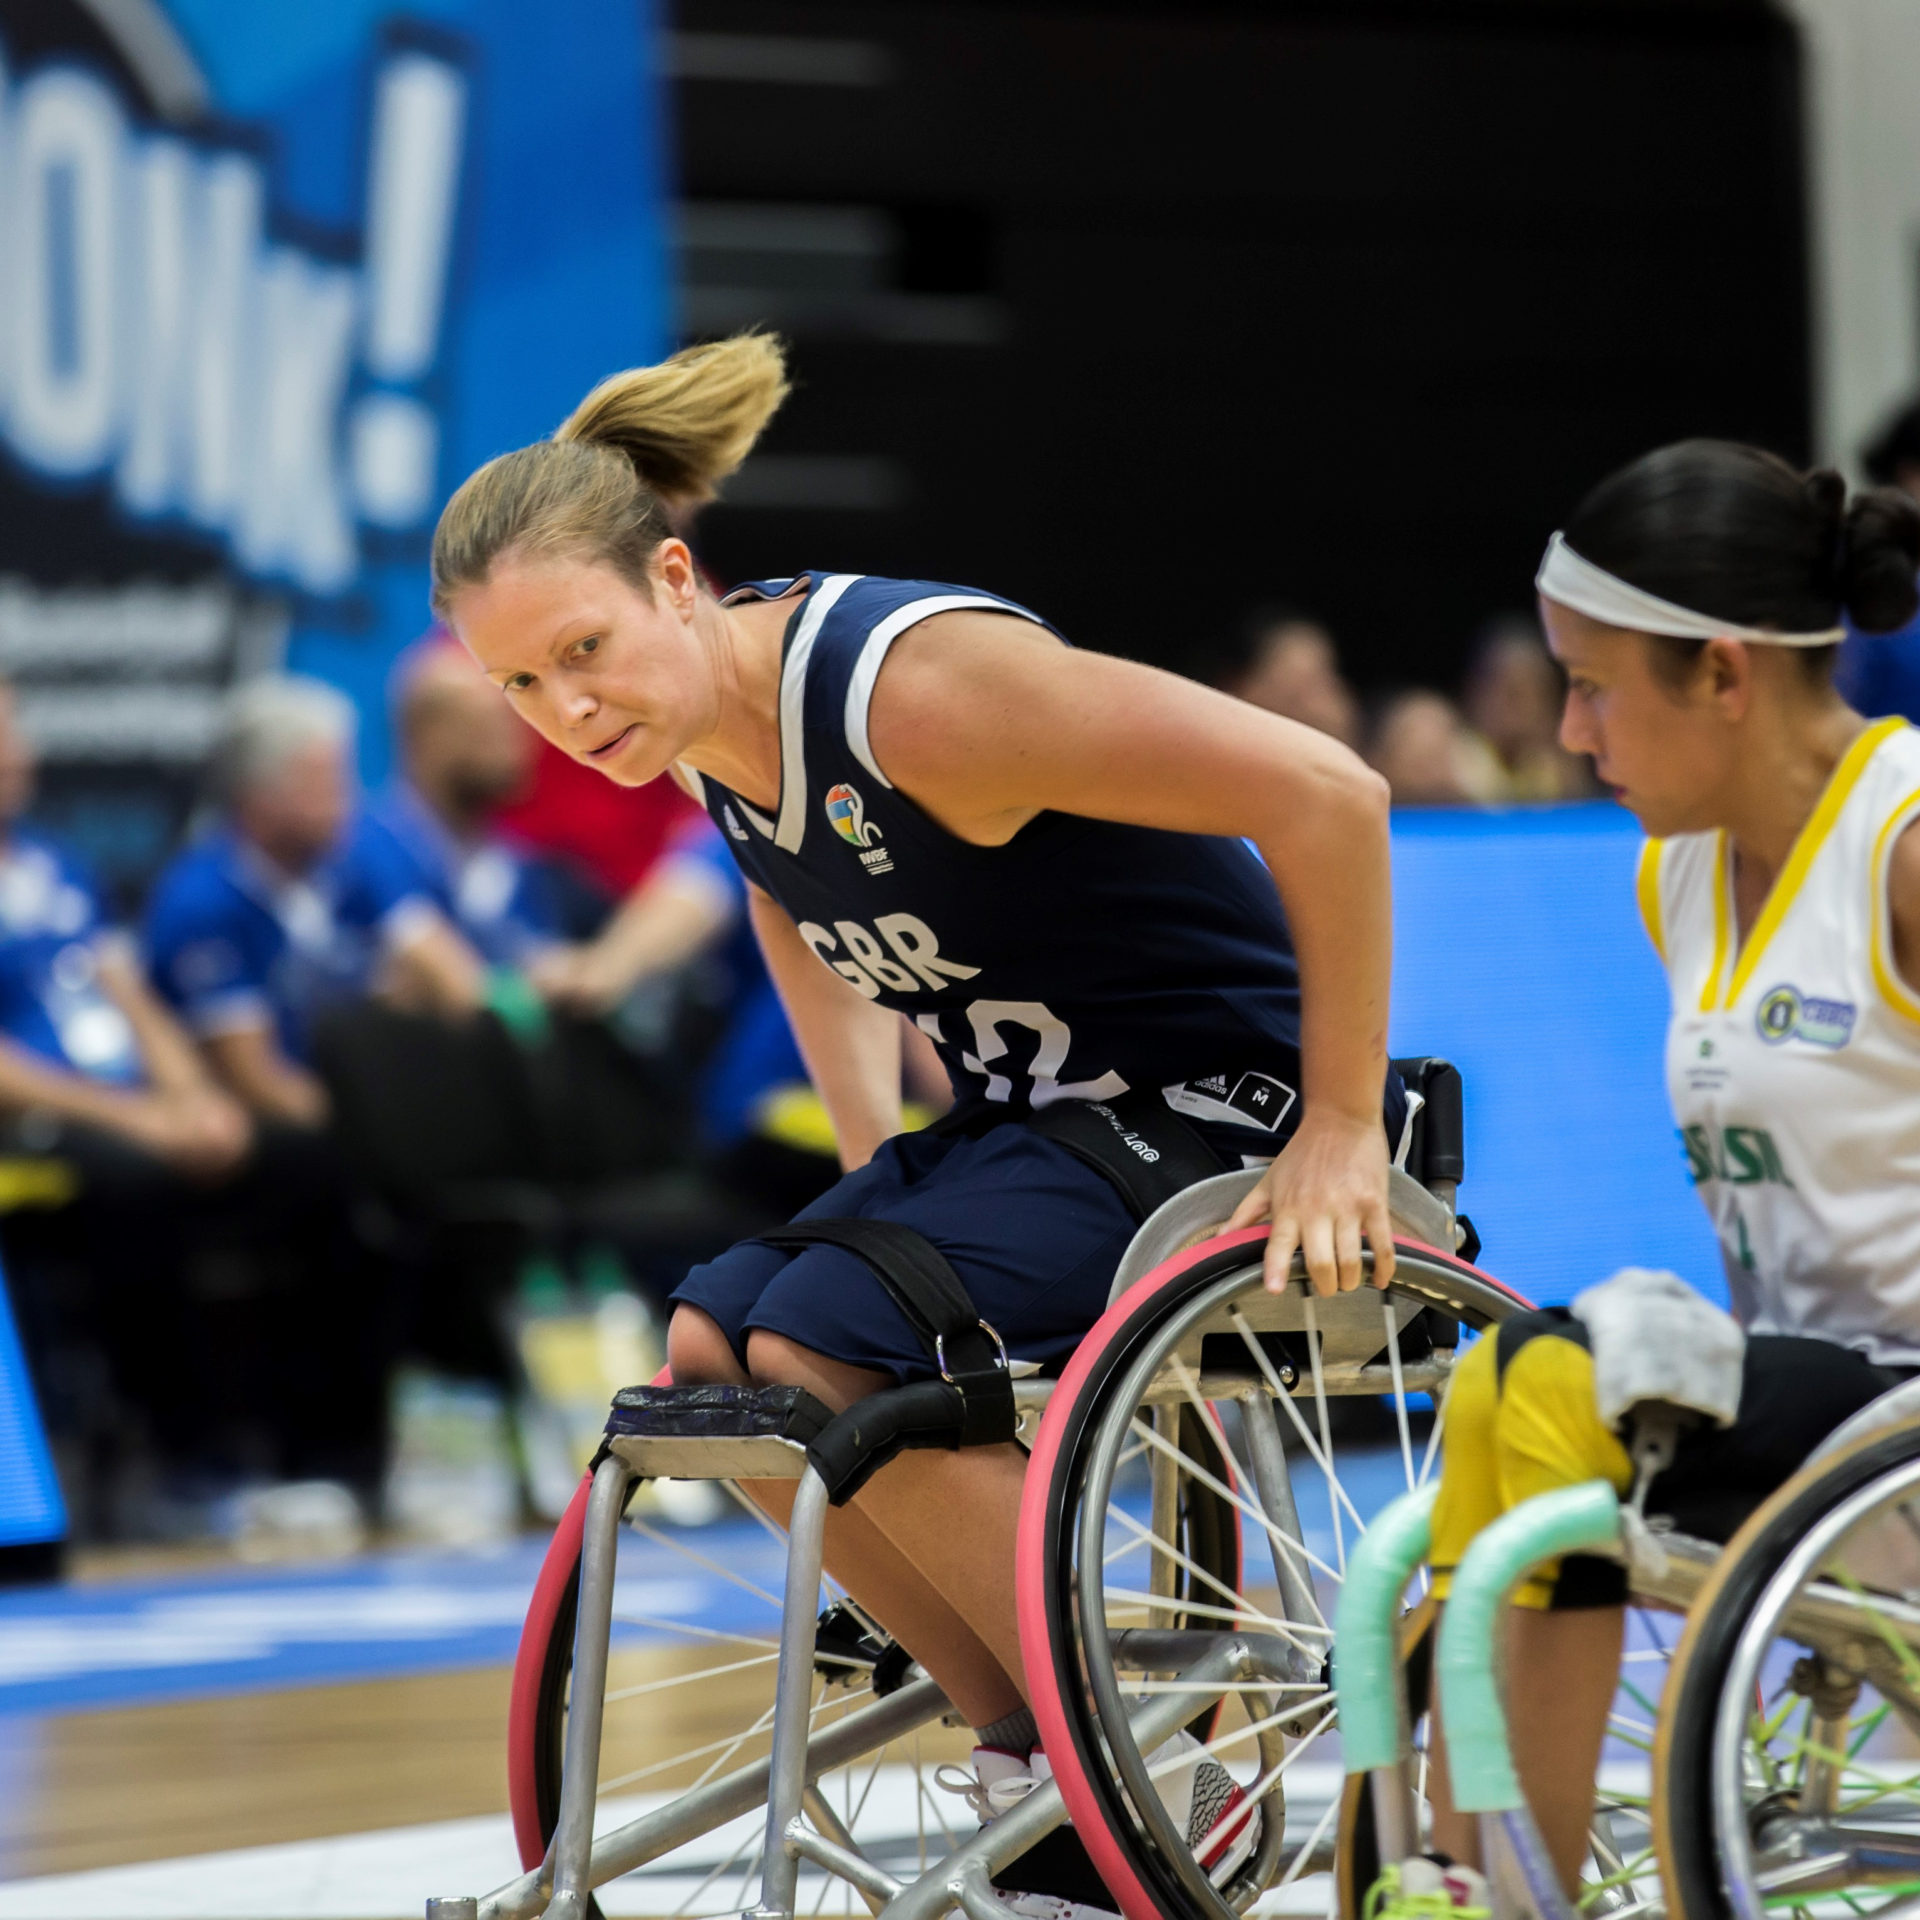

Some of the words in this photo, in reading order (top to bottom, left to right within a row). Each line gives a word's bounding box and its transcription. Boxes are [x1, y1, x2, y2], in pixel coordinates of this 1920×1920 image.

[798, 912, 982, 1000] GBR
[1194, 1080, 1227, 1095] adidas
[1252, 1089, 1269, 1106] M
